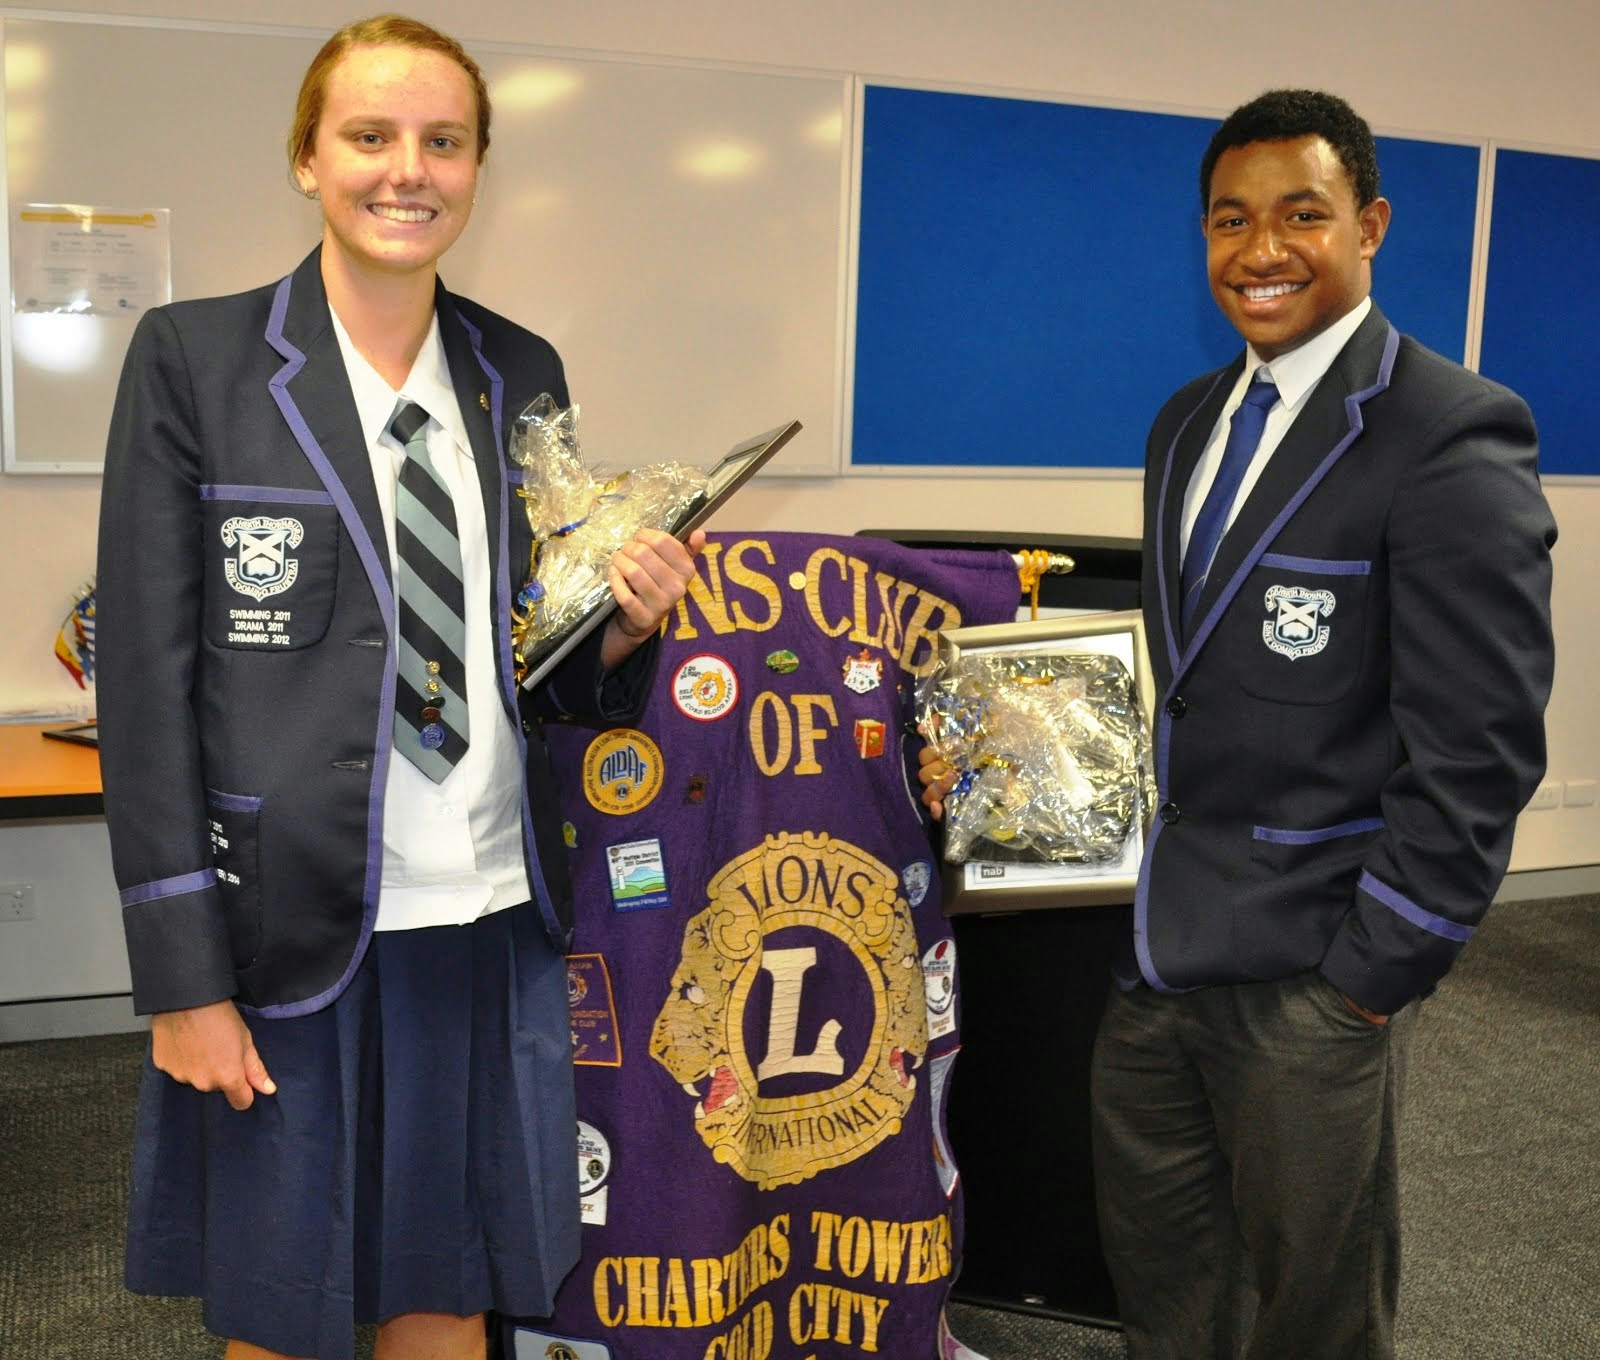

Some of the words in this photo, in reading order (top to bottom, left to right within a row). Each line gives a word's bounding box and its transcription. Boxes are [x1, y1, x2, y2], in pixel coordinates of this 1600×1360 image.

[229, 609, 272, 620] SWIMMING
[273, 610, 291, 621] 2011
[234, 621, 265, 632] DRAMA
[267, 621, 284, 632] 2011
[228, 632, 270, 644] SWIMMING
[271, 633, 290, 645] 2012
[684, 703, 703, 715] CORD
[703, 703, 726, 715] BLOOD
[749, 691, 839, 777] OF
[600, 744, 647, 788] ALDAF
[983, 867, 1003, 876] nab
[758, 947, 844, 1081] L
[592, 1212, 790, 1328] CHARTERS
[789, 1283, 889, 1352] CITY
